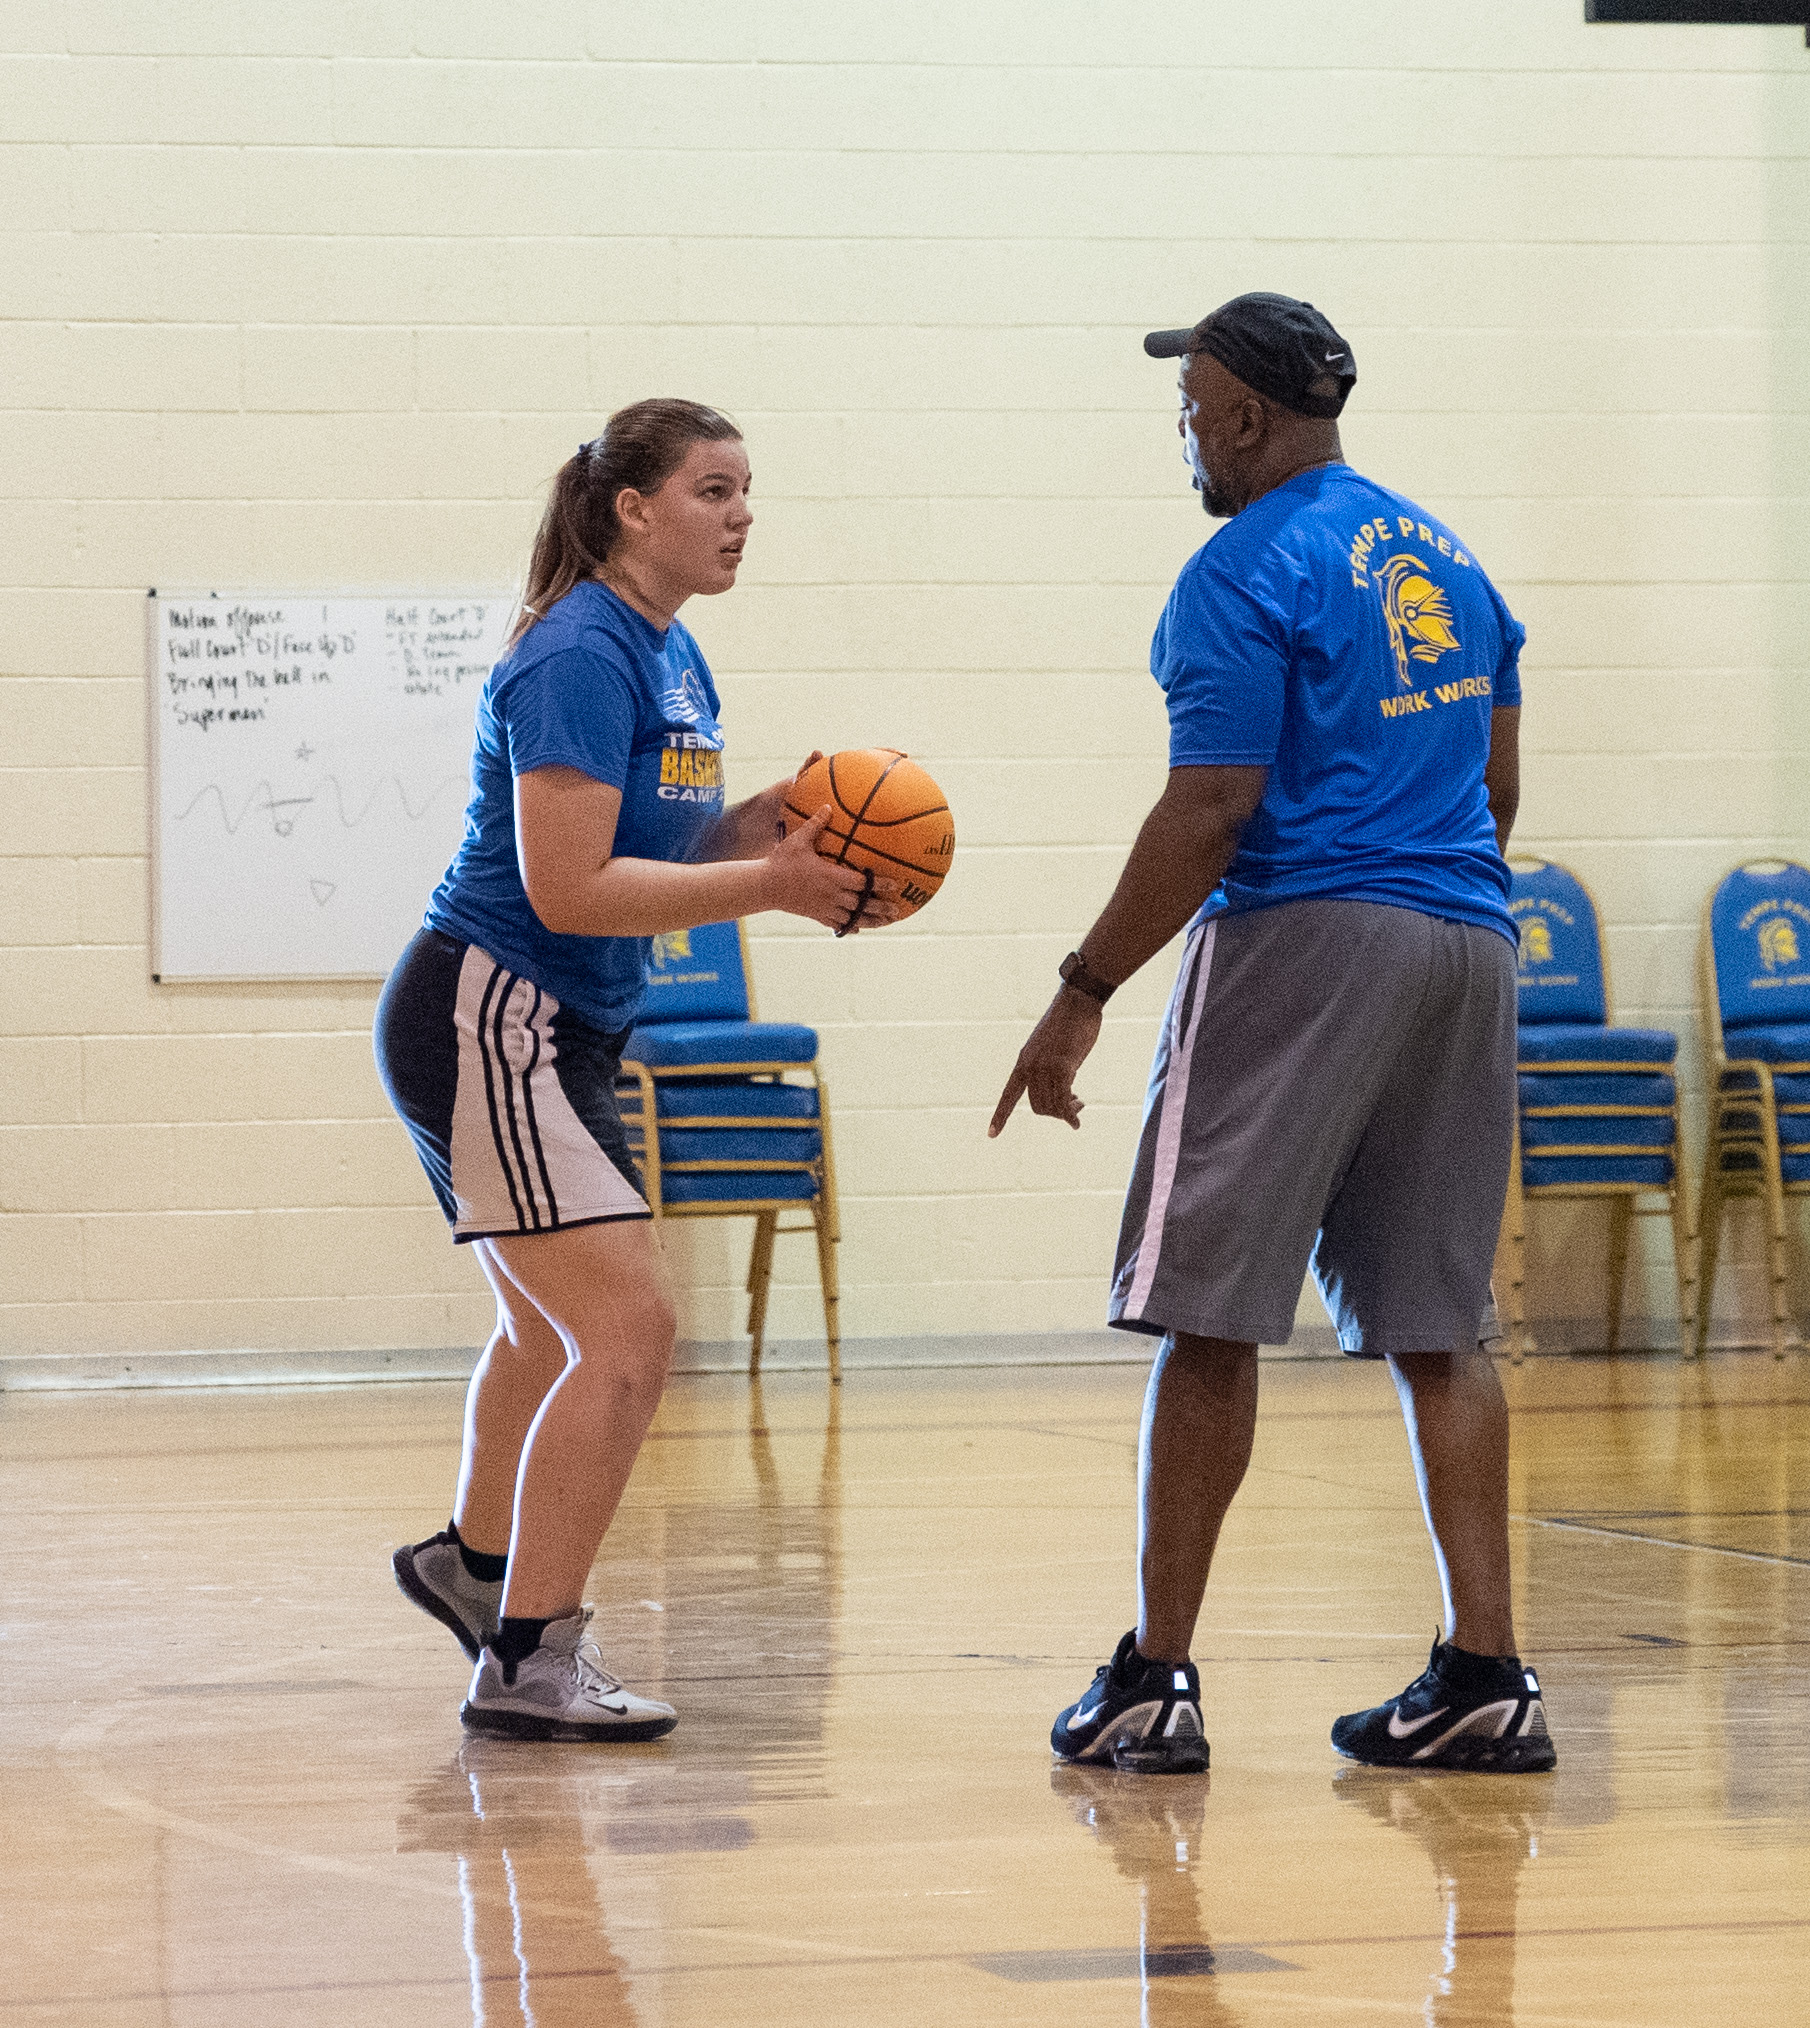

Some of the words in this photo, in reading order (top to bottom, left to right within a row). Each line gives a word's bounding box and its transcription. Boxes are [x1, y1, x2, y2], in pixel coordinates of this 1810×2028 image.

[1350, 517, 1393, 589] TEMPE
[1397, 516, 1470, 568] PREP
[1434, 676, 1492, 704] WRS
[657, 786, 717, 803] CAMP
